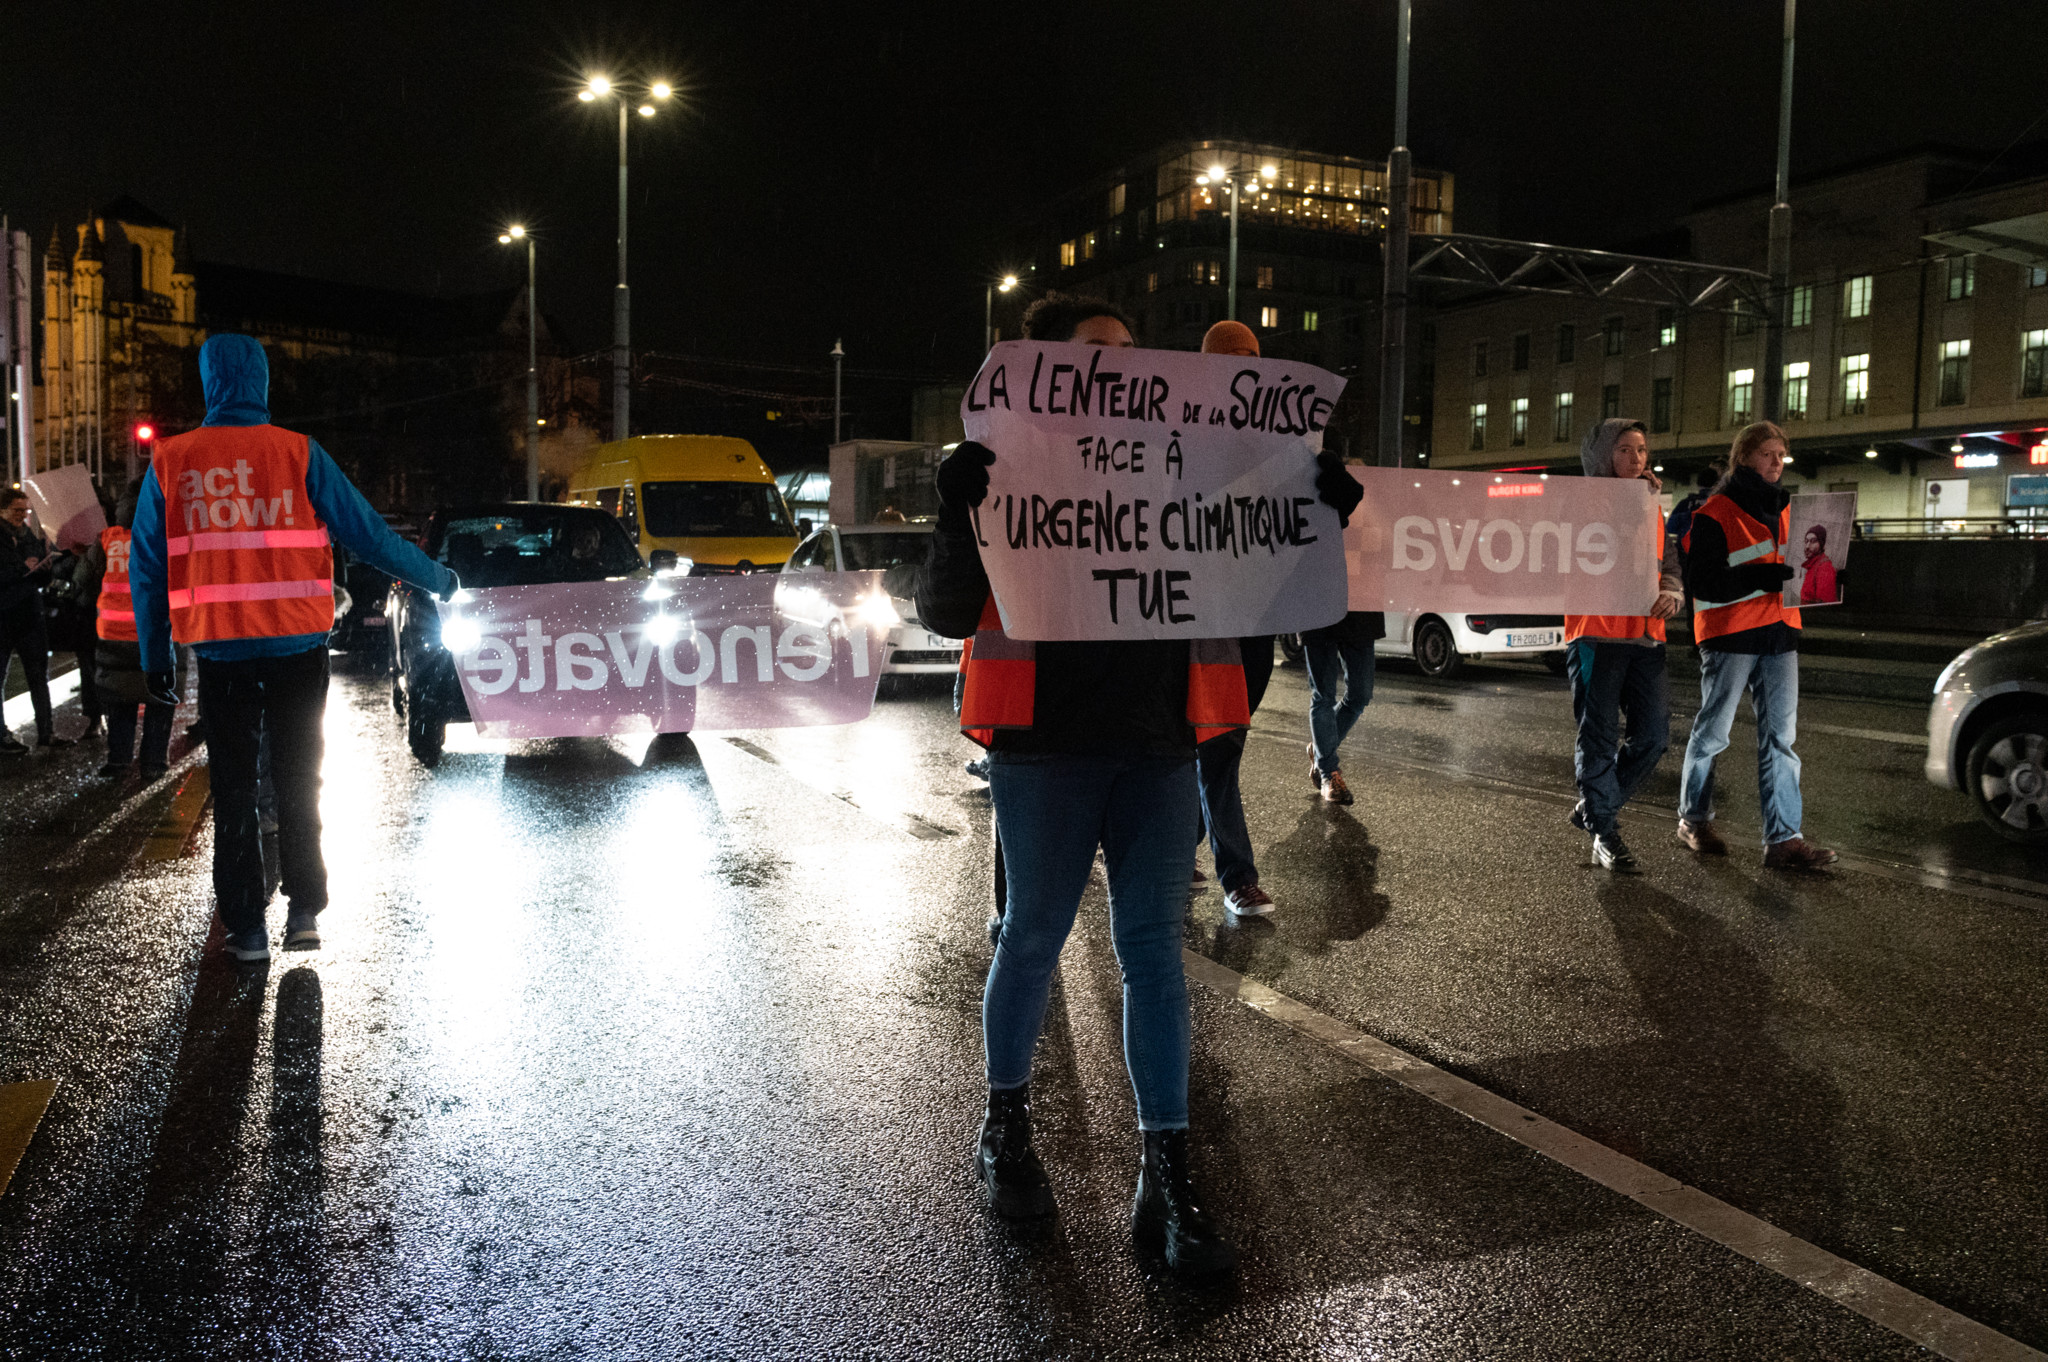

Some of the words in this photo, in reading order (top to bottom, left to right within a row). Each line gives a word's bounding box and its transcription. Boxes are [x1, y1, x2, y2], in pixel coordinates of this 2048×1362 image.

[968, 364, 1011, 412] LA
[1029, 350, 1169, 423] LENTEUR
[1183, 401, 1202, 424] DE
[1209, 407, 1225, 428] LA
[1077, 436, 1146, 475] FACE
[178, 459, 255, 500] act
[1487, 484, 1520, 498] BURGER
[1520, 482, 1544, 496] KING
[183, 489, 294, 532] now!
[1092, 568, 1196, 624] TUE
